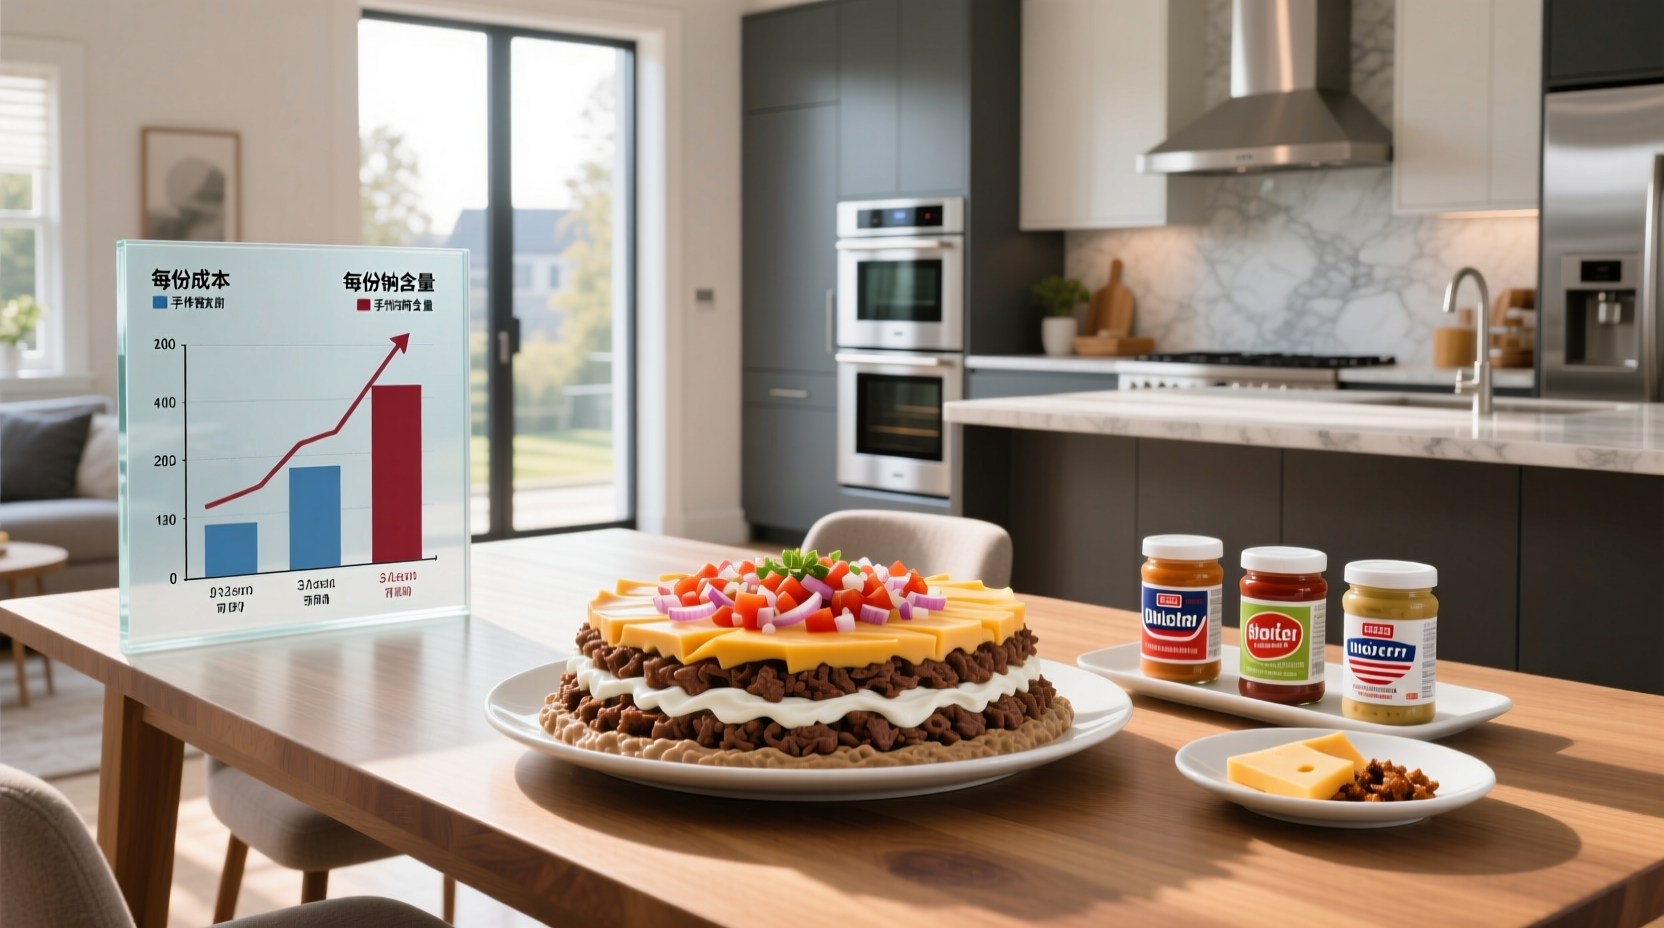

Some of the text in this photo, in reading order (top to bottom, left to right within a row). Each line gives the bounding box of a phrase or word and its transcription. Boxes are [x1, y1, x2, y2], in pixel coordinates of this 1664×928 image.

[152, 268, 230, 290] 每份成本
[343, 271, 435, 293] 每份钠含量
[154, 338, 176, 350] 200
[154, 397, 177, 408] 400
[154, 455, 177, 467] 200
[169, 573, 177, 585] 0
